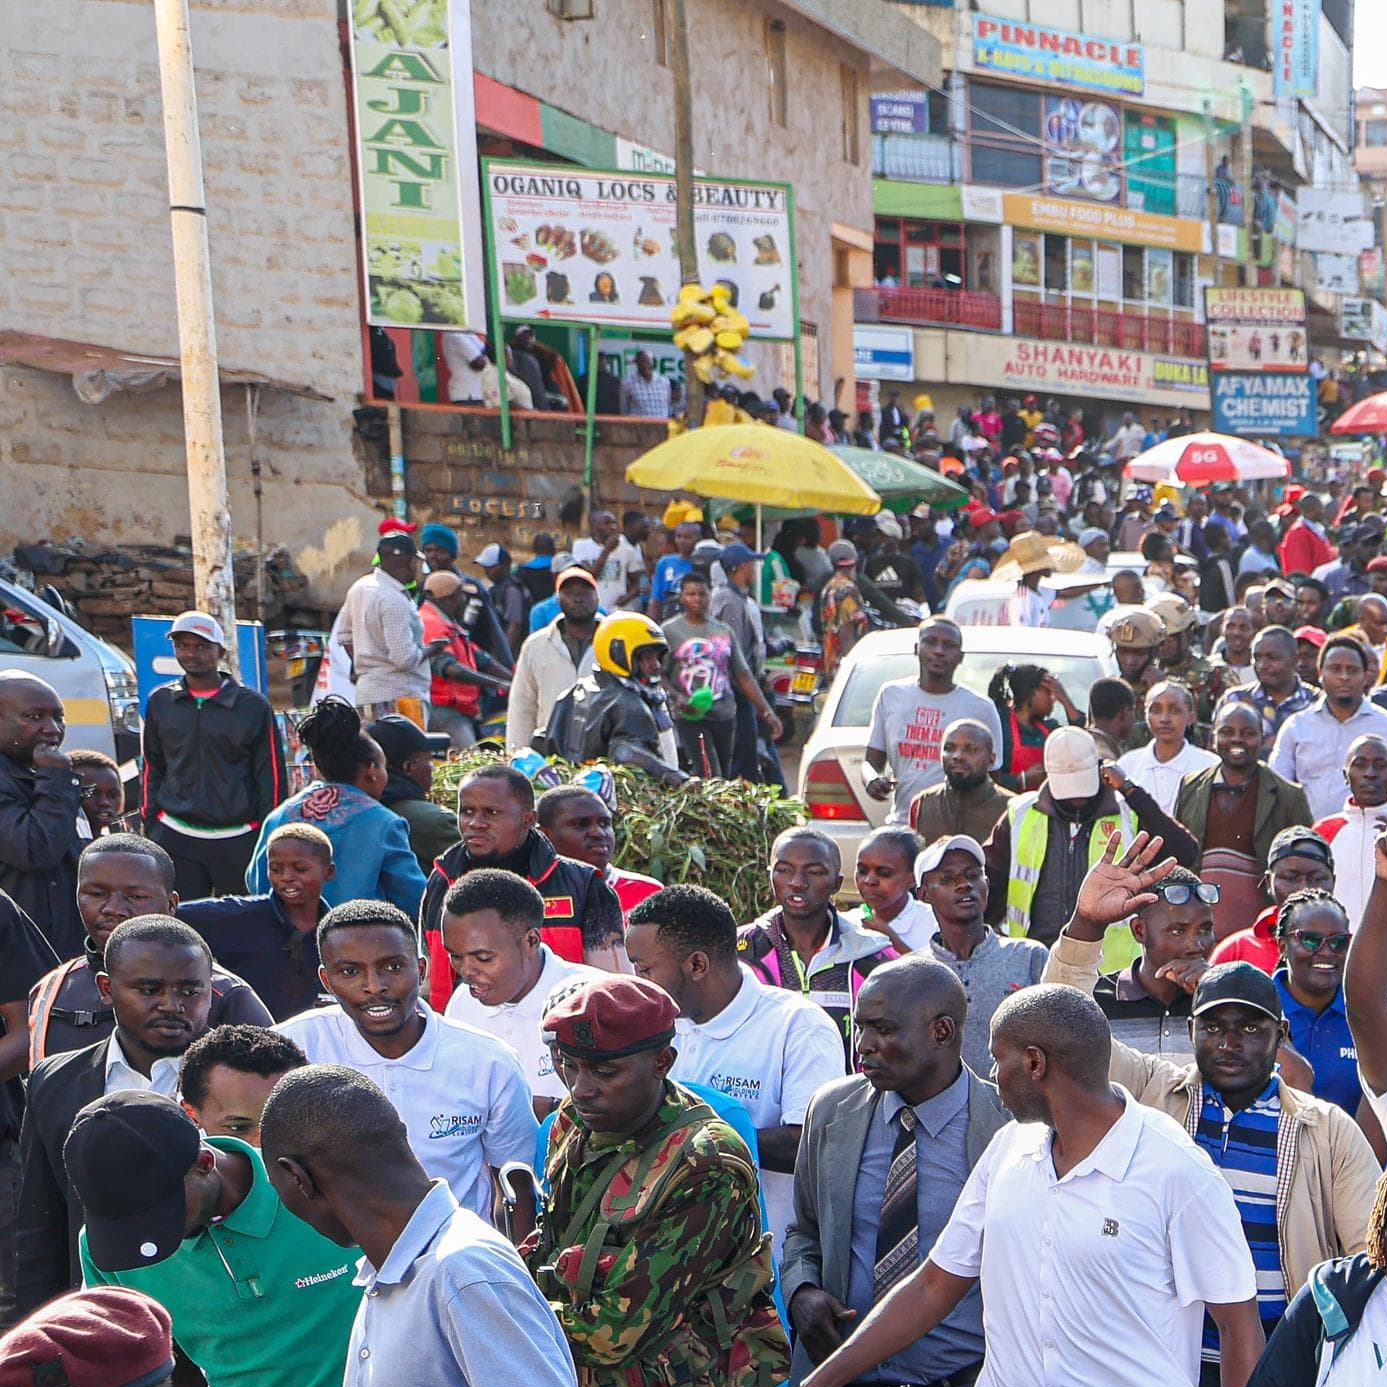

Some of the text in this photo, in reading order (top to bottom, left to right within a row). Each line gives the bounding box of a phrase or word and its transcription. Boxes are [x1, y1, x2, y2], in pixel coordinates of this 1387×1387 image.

[978, 19, 1140, 67] PINNACLE
[361, 51, 448, 210] AJANI
[493, 174, 584, 199] OGANIQ
[597, 180, 656, 201] LOCS
[1017, 343, 1143, 373] SHANYAKI
[1004, 361, 1139, 386] AUTO HARDWARE
[1216, 376, 1310, 396] AFYAMAX
[1221, 399, 1309, 418] CHEMIST
[726, 1076, 760, 1089] RISAM
[452, 1115, 481, 1126] RISAM
[305, 1264, 349, 1287] Heineken
